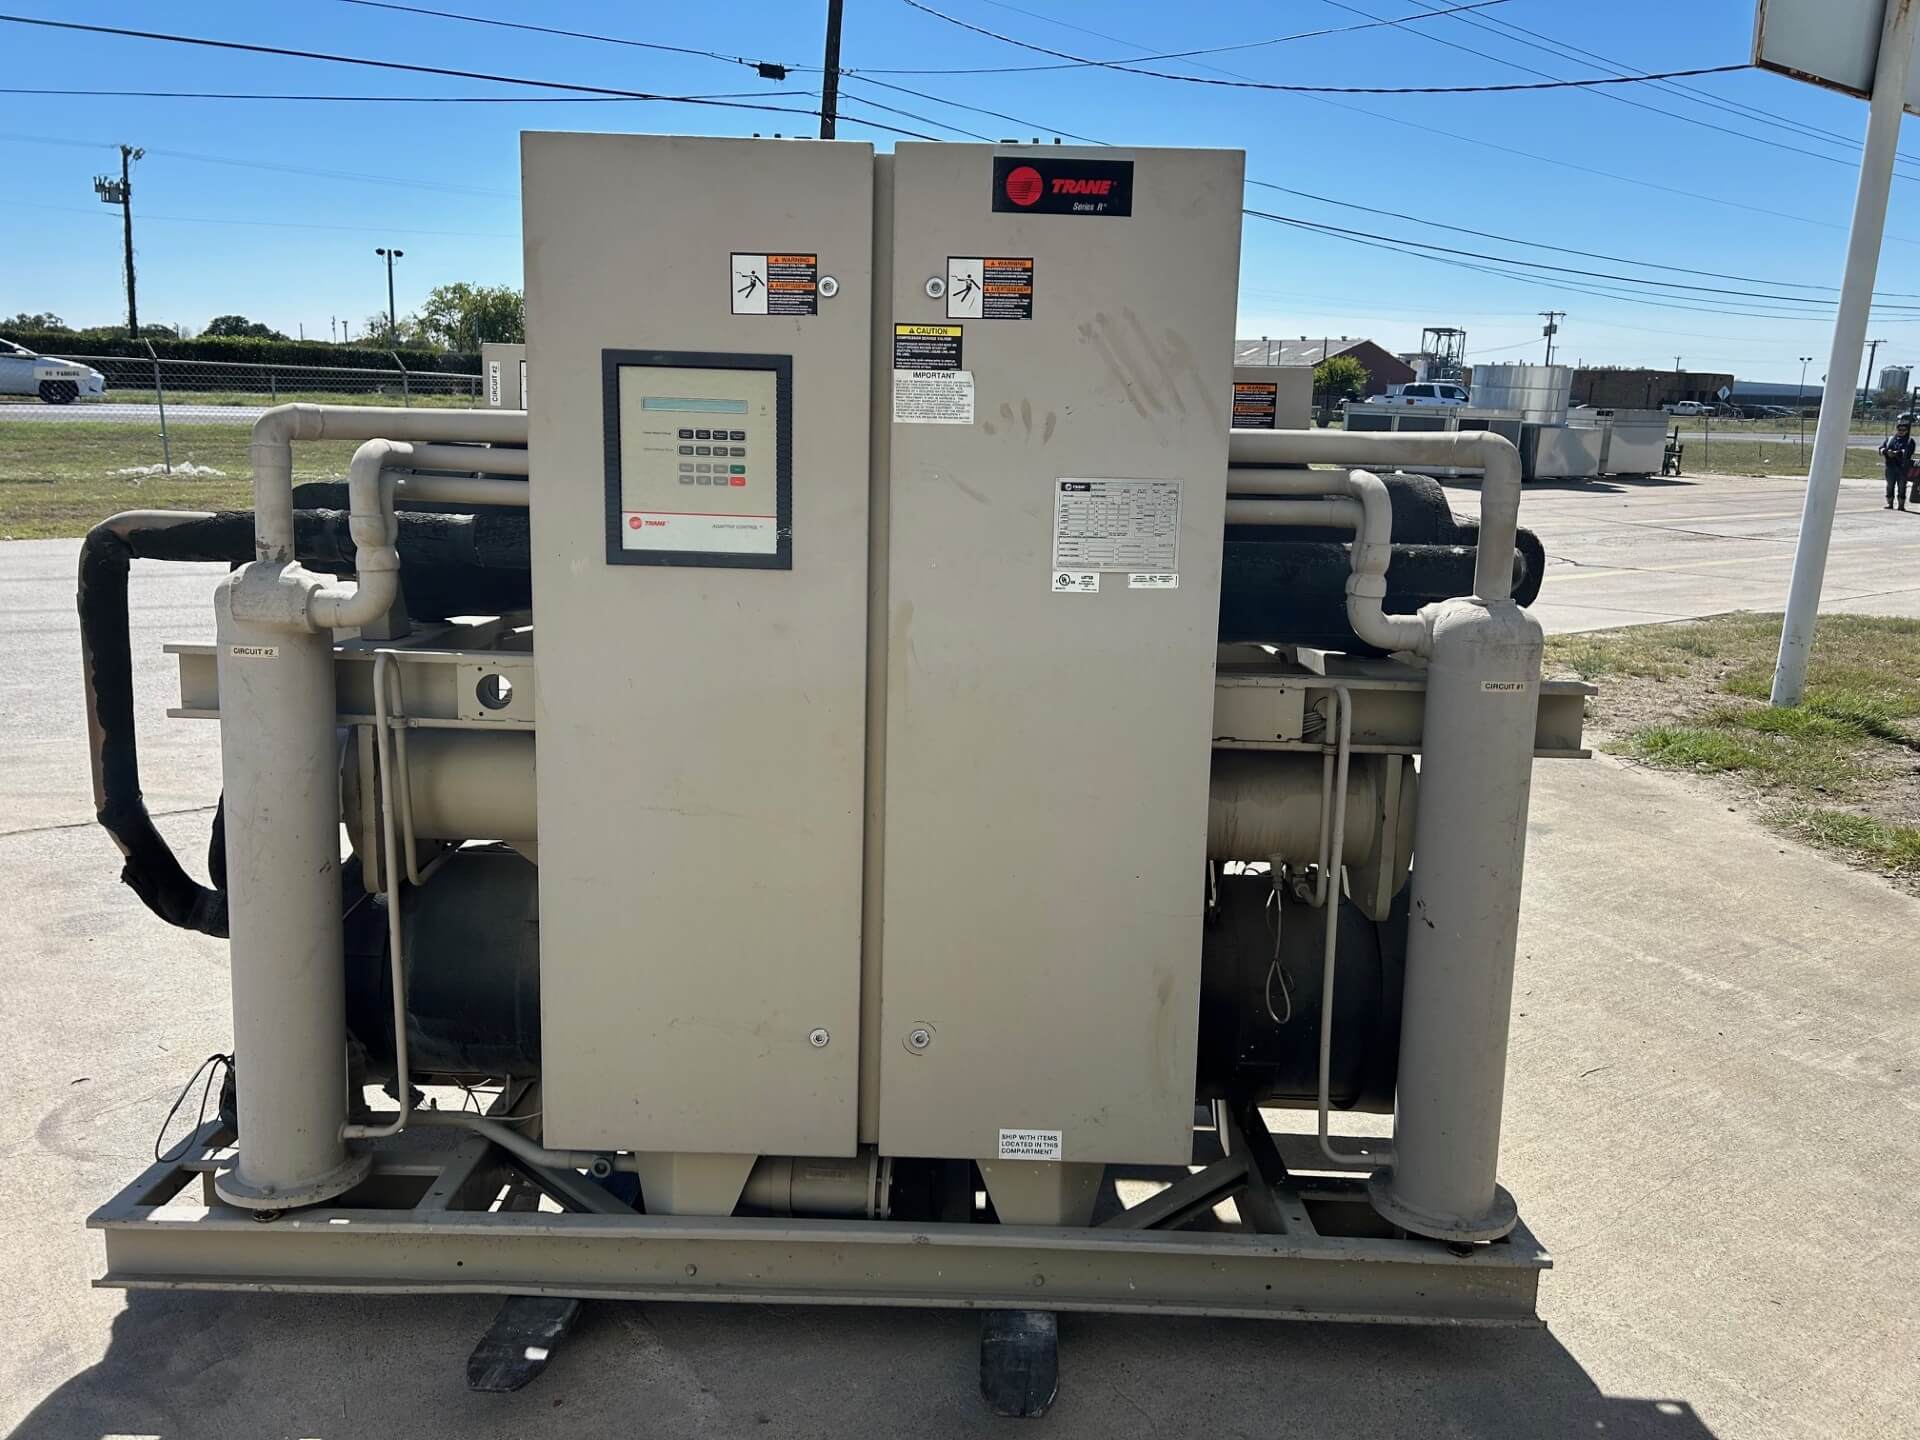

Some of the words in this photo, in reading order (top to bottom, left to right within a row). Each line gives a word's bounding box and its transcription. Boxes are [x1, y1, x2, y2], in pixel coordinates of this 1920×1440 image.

[1052, 178, 1112, 195] TRANE
[1073, 202, 1095, 211] Series
[916, 327, 948, 335] CAUTION
[912, 371, 956, 379] IMPORTANT
[233, 647, 262, 655] CIRCUIT
[1485, 682, 1515, 690] CIRCUIT
[1001, 1147, 1053, 1155] COMPARTMENT
